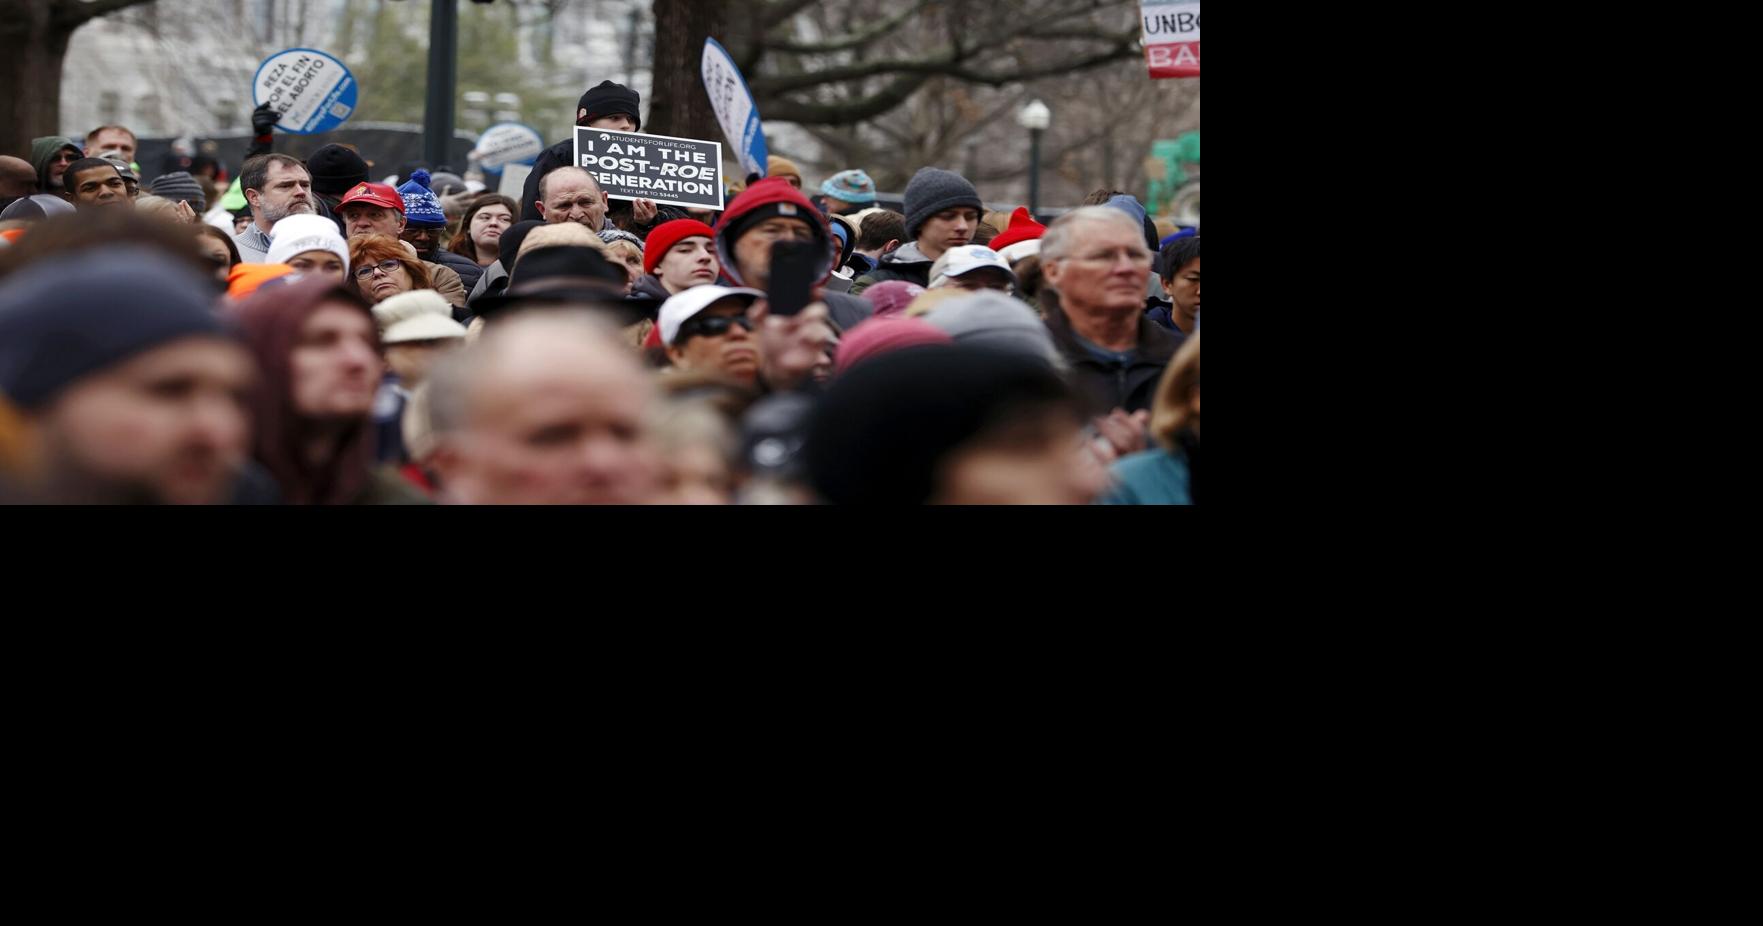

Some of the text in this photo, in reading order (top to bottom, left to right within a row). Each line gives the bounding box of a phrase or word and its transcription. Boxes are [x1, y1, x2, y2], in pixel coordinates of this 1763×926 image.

[1149, 45, 1200, 67] BA
[263, 63, 287, 88] REZA
[282, 75, 296, 87] EL
[292, 55, 310, 73] FIN
[289, 59, 324, 101] ABORTO
[588, 140, 707, 164] I AM THE
[611, 135, 697, 150] STUDENTSFORLIFE.ORG
[581, 153, 716, 181] POST-ROE
